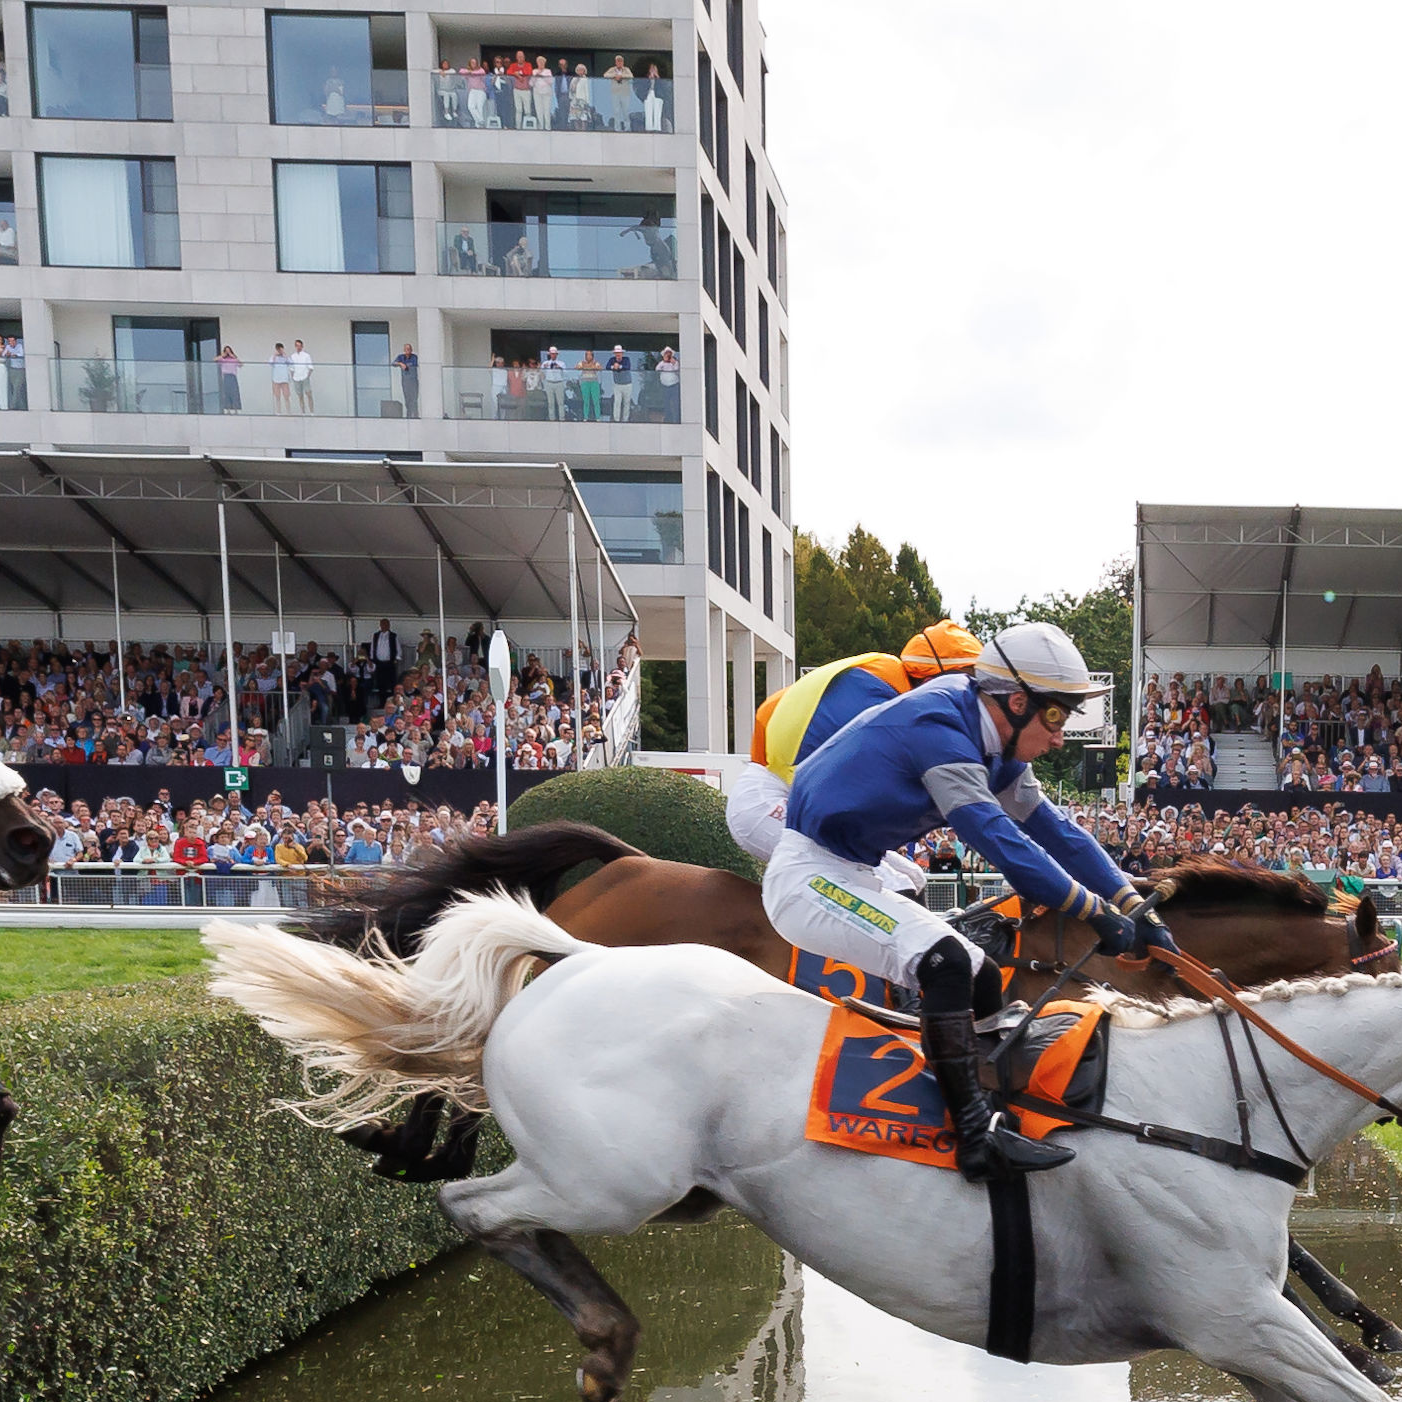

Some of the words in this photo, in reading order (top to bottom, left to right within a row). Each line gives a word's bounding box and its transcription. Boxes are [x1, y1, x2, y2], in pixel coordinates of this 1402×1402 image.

[819, 957, 866, 1007] 5
[859, 1040, 926, 1116] 2
[829, 1114, 957, 1153] WAREG
